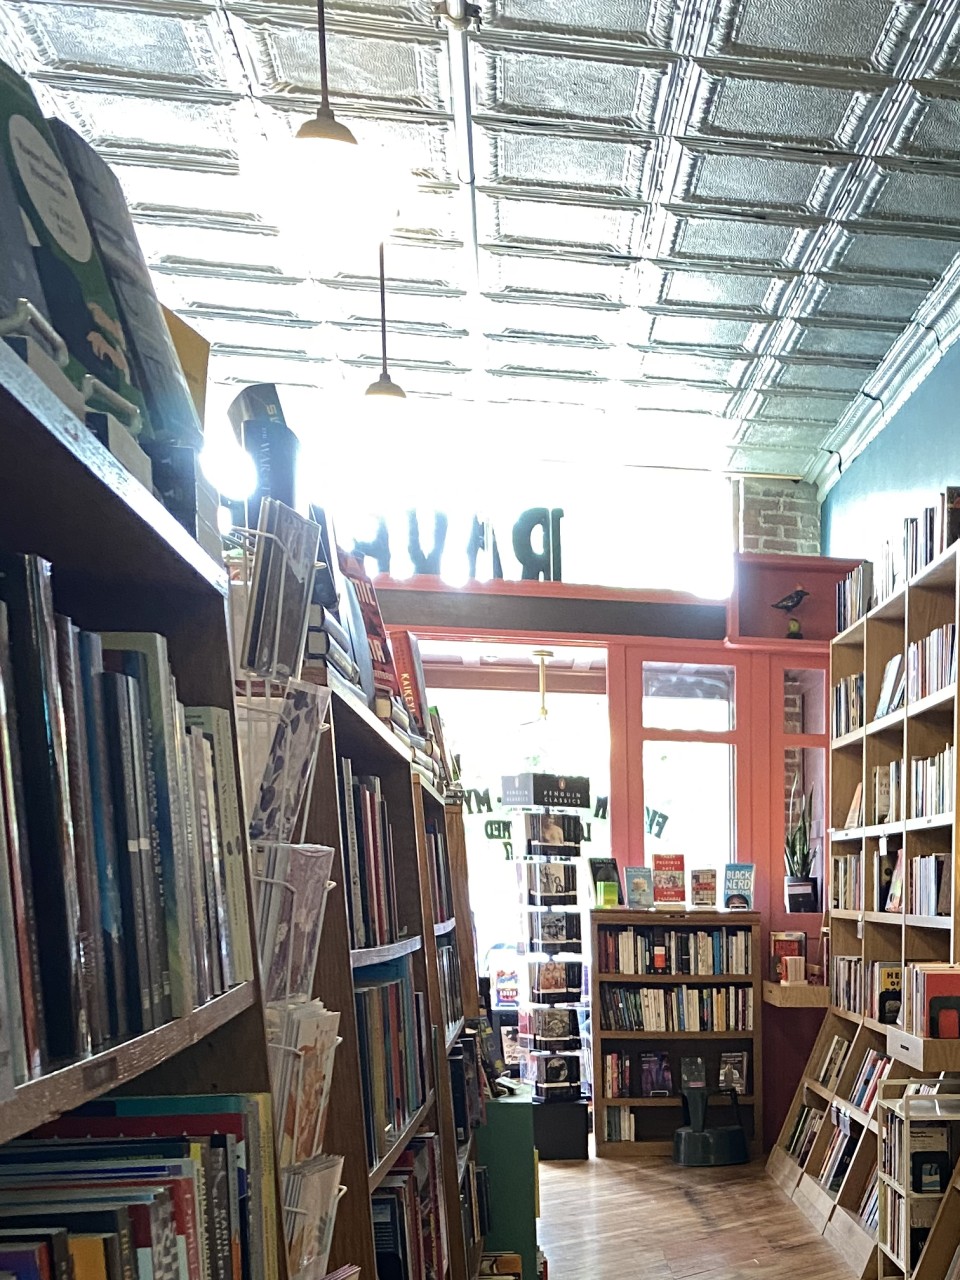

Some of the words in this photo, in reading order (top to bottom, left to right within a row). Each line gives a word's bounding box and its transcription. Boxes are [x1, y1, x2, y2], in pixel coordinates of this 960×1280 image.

[399, 672, 417, 714] KAIKEYI
[544, 790, 582, 798] PENGUIN
[544, 797, 582, 805] CLASSICS
[726, 870, 752, 879] BLACK
[726, 880, 751, 890] NERD
